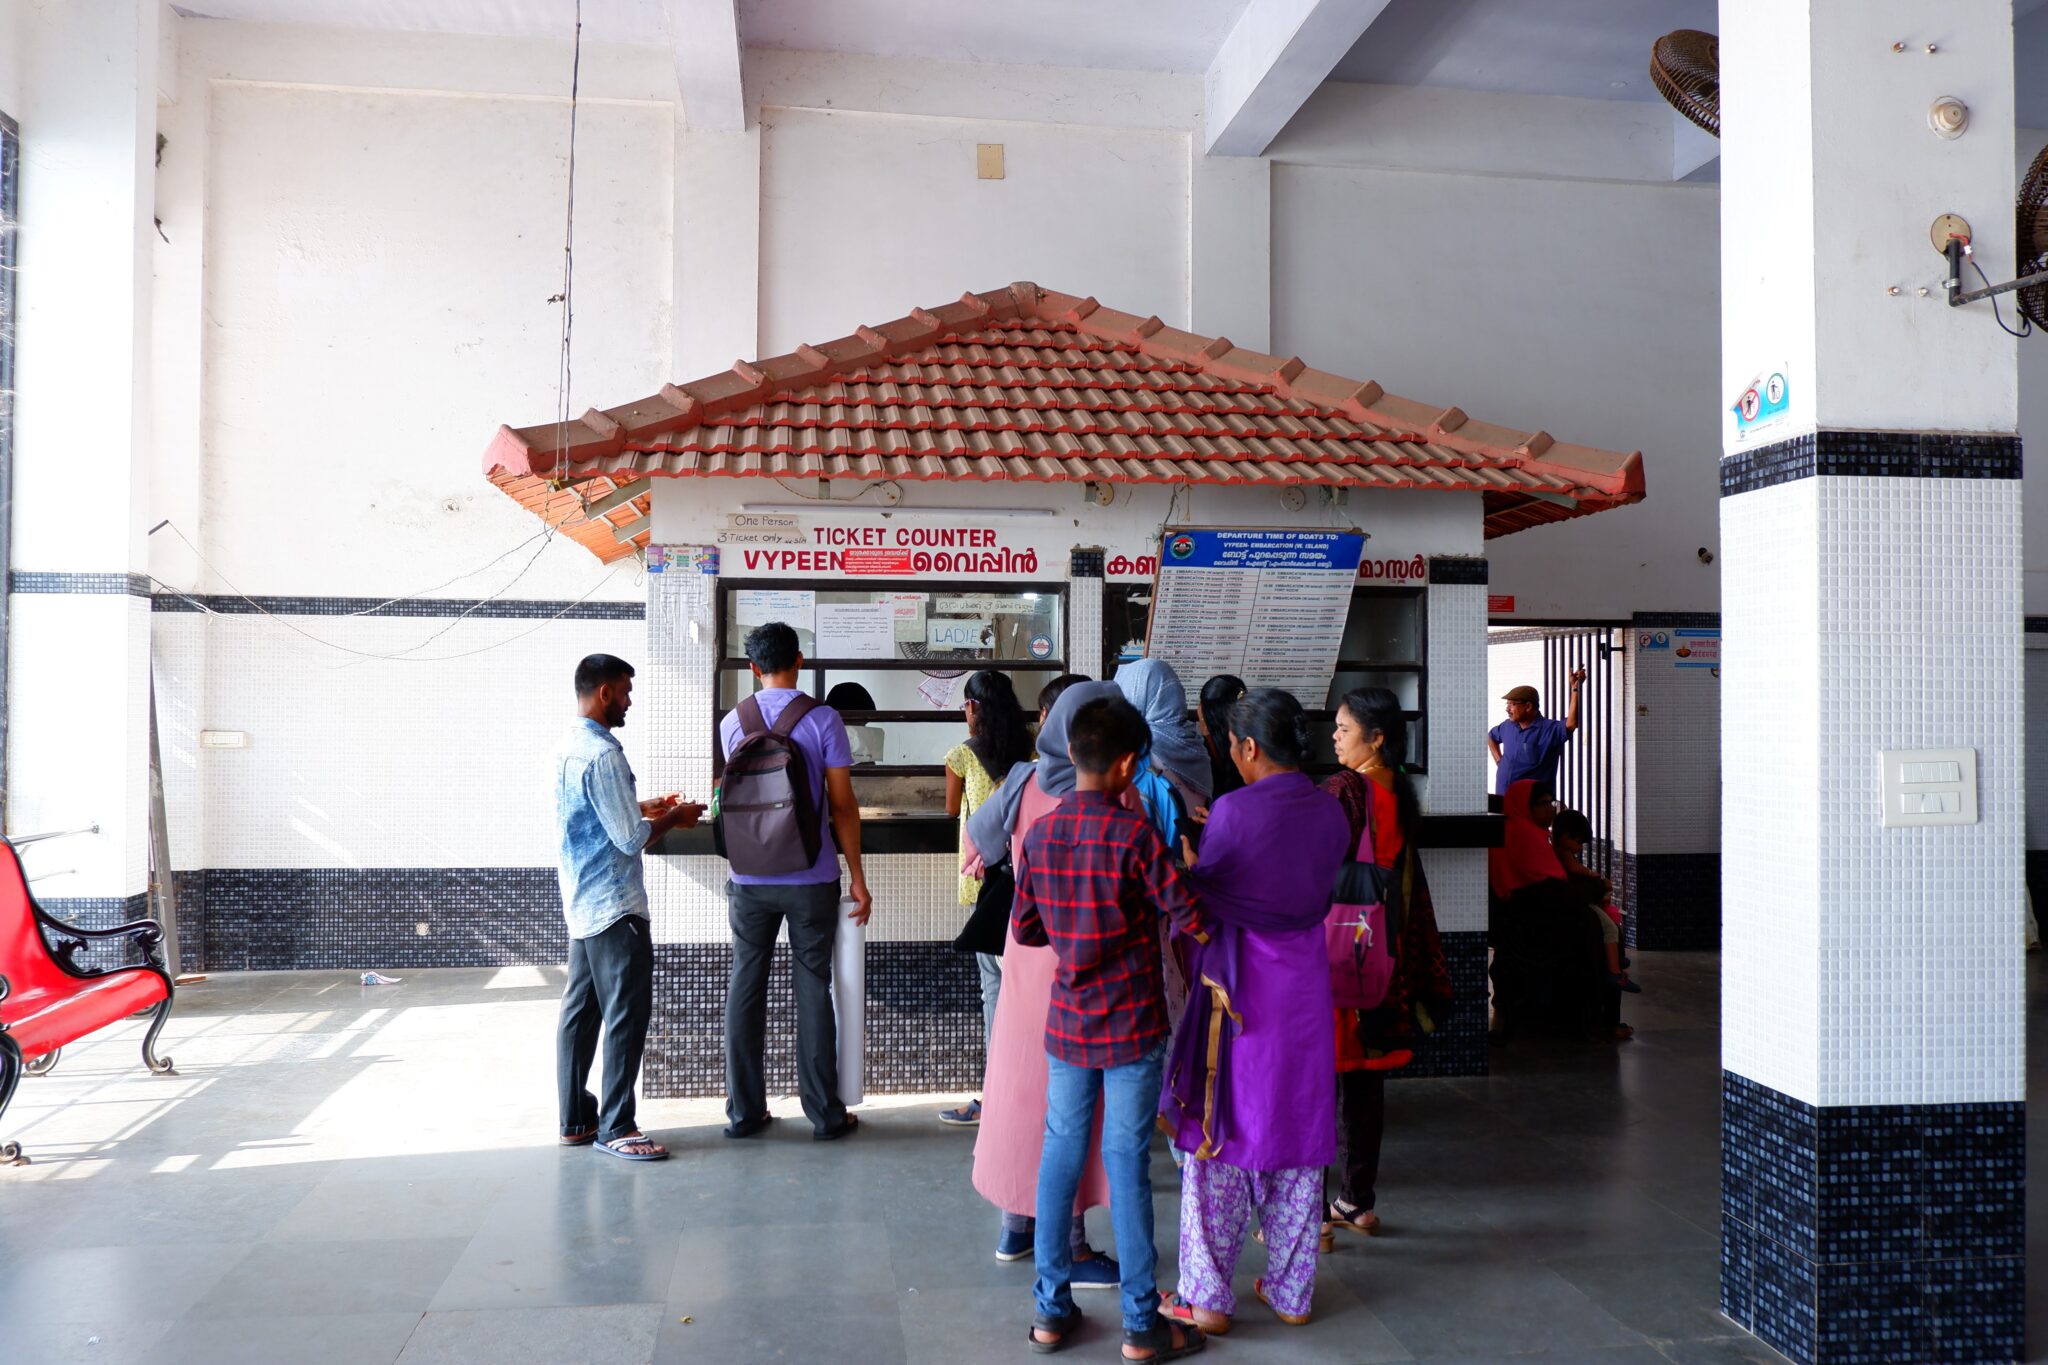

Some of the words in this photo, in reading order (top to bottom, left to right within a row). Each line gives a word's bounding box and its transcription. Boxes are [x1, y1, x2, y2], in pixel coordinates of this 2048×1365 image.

[735, 515, 759, 526] One
[762, 516, 794, 526] Person
[717, 532, 727, 543] 3
[729, 533, 757, 542] Ticket
[762, 533, 783, 543] only
[813, 527, 886, 546] TICKET
[896, 528, 997, 547] COUNTER
[743, 550, 845, 571] VYPEEN
[912, 547, 1038, 573] വൈപ്പിൻ
[935, 628, 982, 643] LADIE
